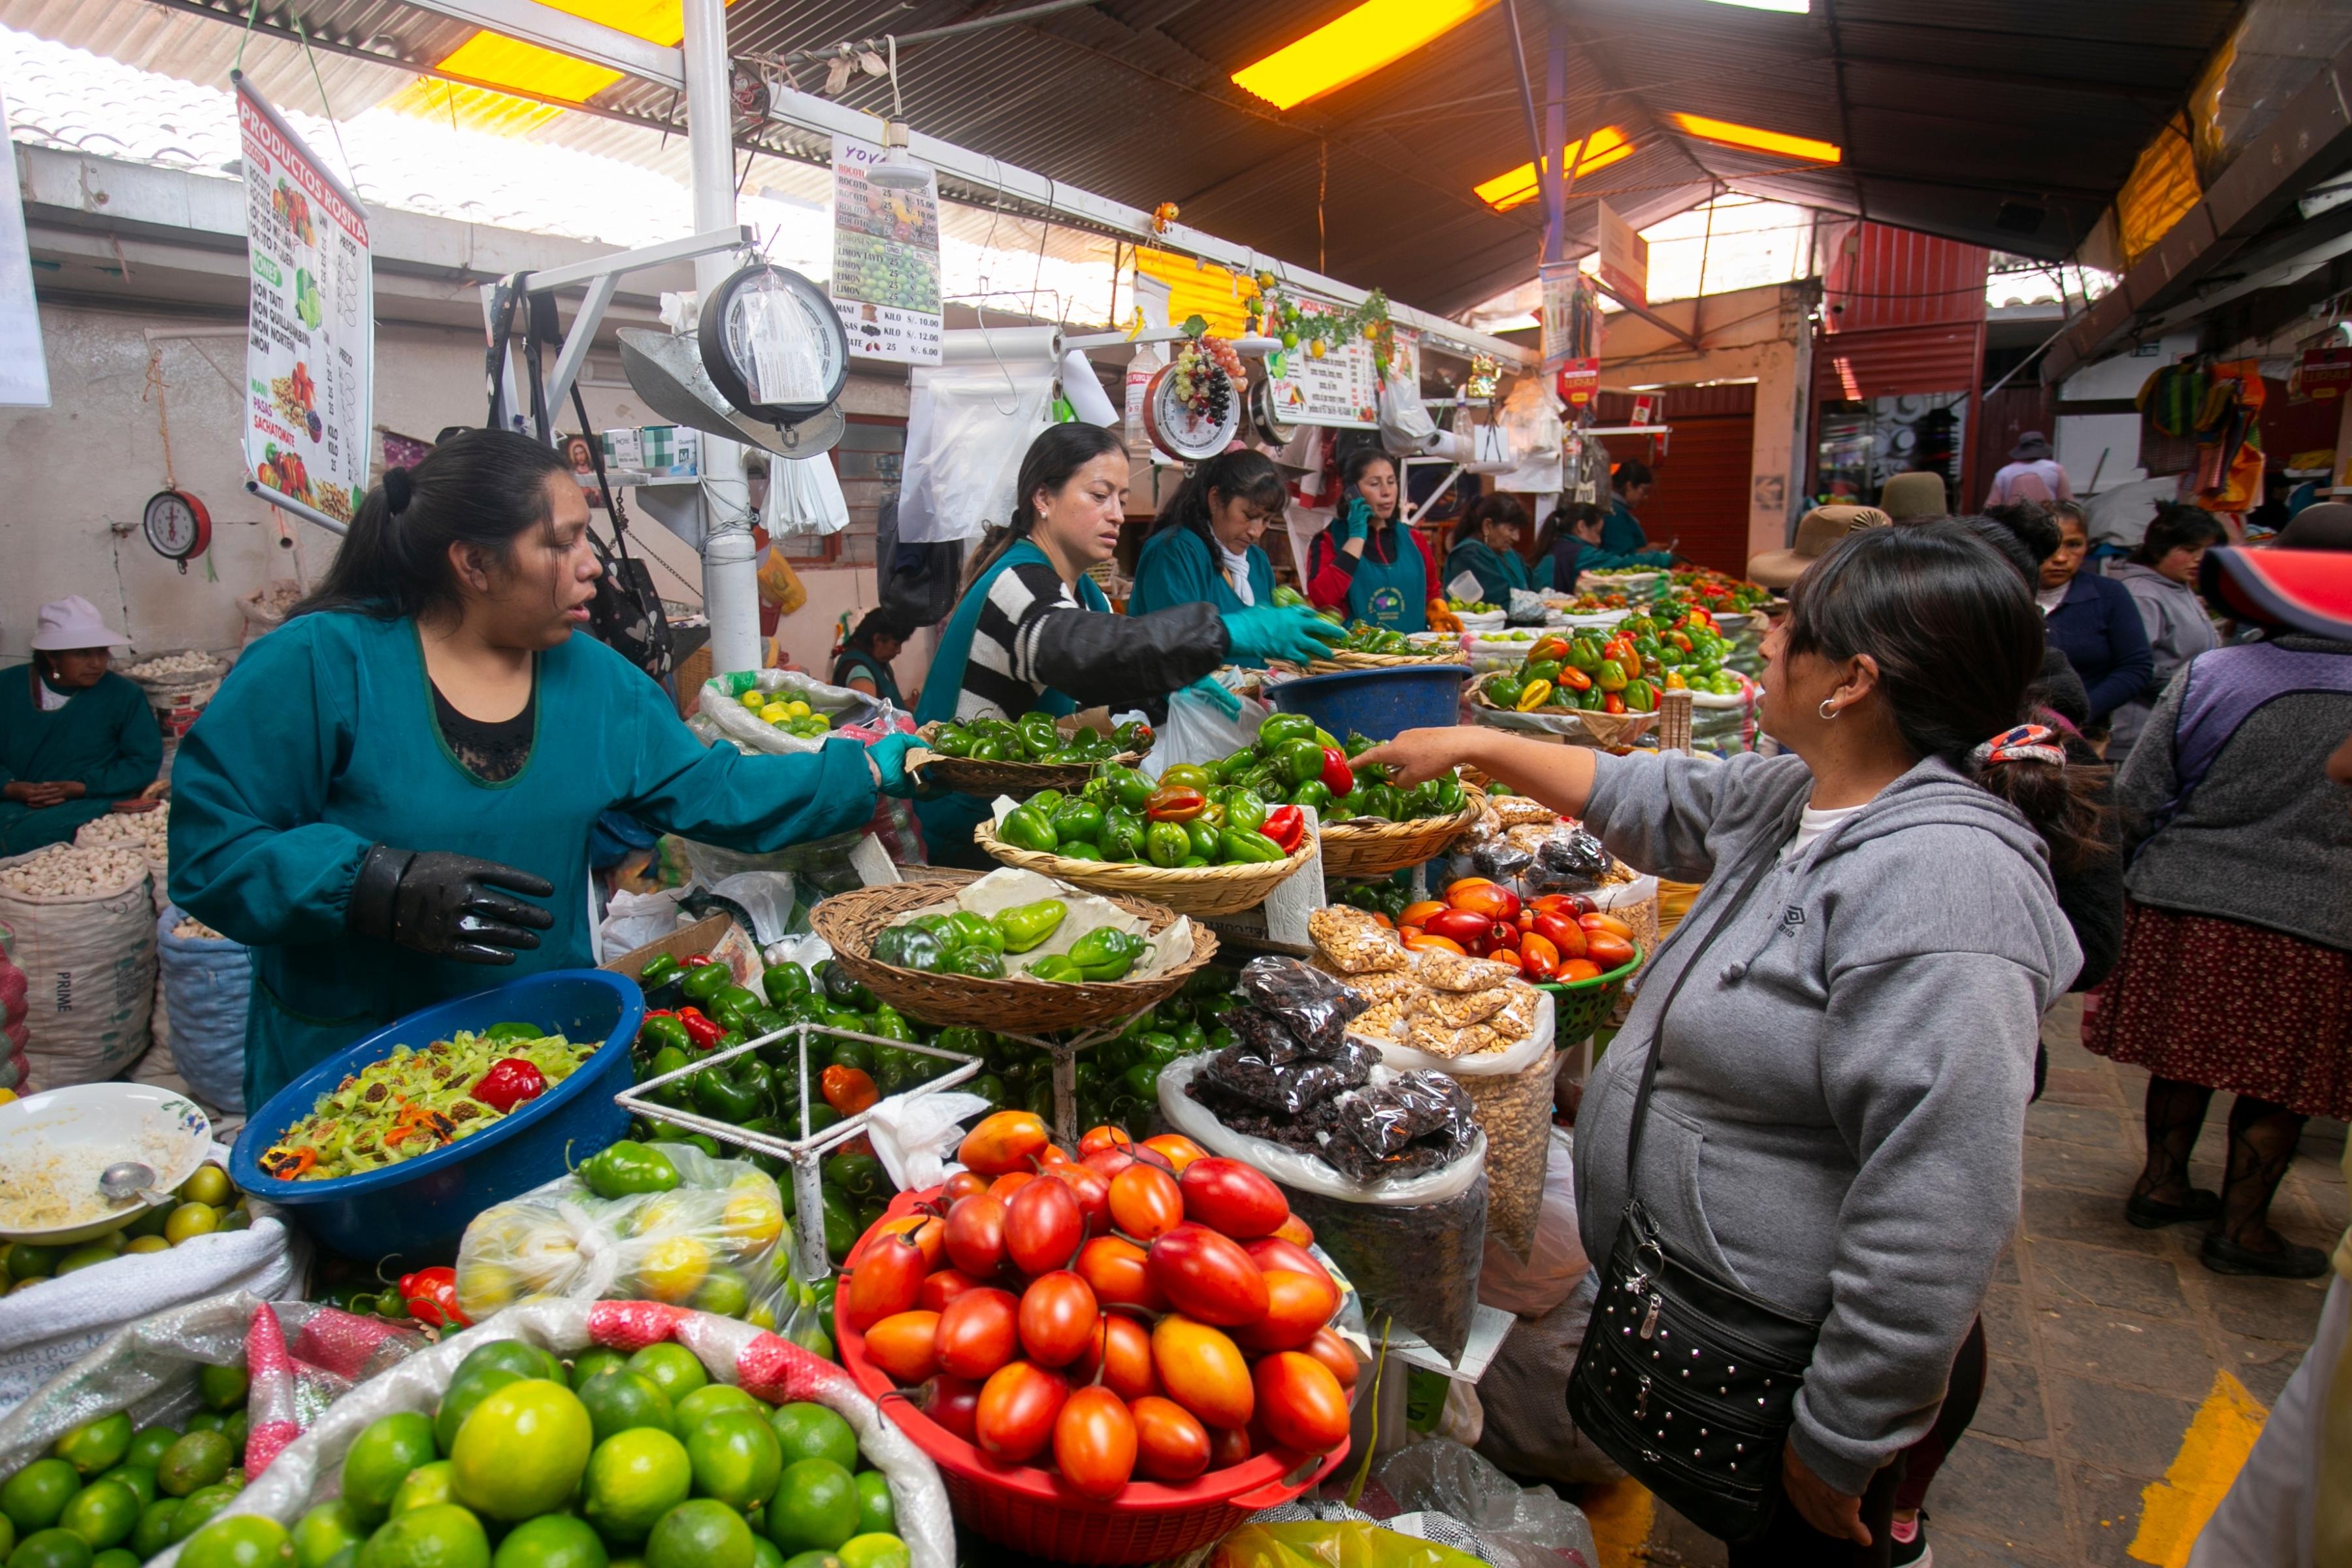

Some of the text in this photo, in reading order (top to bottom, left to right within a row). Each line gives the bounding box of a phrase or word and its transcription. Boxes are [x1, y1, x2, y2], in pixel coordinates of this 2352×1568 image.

[240, 101, 367, 243] PRODUCTOS ROSITA
[839, 176, 892, 197] ROCOTO 25
[839, 189, 868, 203] ROCOTO
[917, 210, 935, 221] 10.00
[839, 202, 868, 216] ROCOTO
[885, 214, 893, 222] 25
[917, 199, 934, 209] 15.00
[340, 234, 357, 257] PRECIO
[838, 248, 861, 259] LIMON
[889, 257, 898, 266] 25
[838, 259, 861, 270] LIMON
[889, 269, 898, 278] 25
[836, 284, 860, 295] LIMON
[837, 272, 860, 283] LIMON
[889, 281, 898, 289] 25
[836, 304, 854, 314] MANI
[885, 312, 902, 321] KILO
[920, 318, 939, 327] 10.00
[843, 321, 858, 331] SAS
[884, 327, 901, 336] KILO
[919, 332, 938, 342] 12.00
[923, 348, 938, 356] 6.00
[253, 396, 272, 417] PASAS
[254, 415, 295, 448] SACHATOMATE
[57, 972, 72, 1012] PRIME
